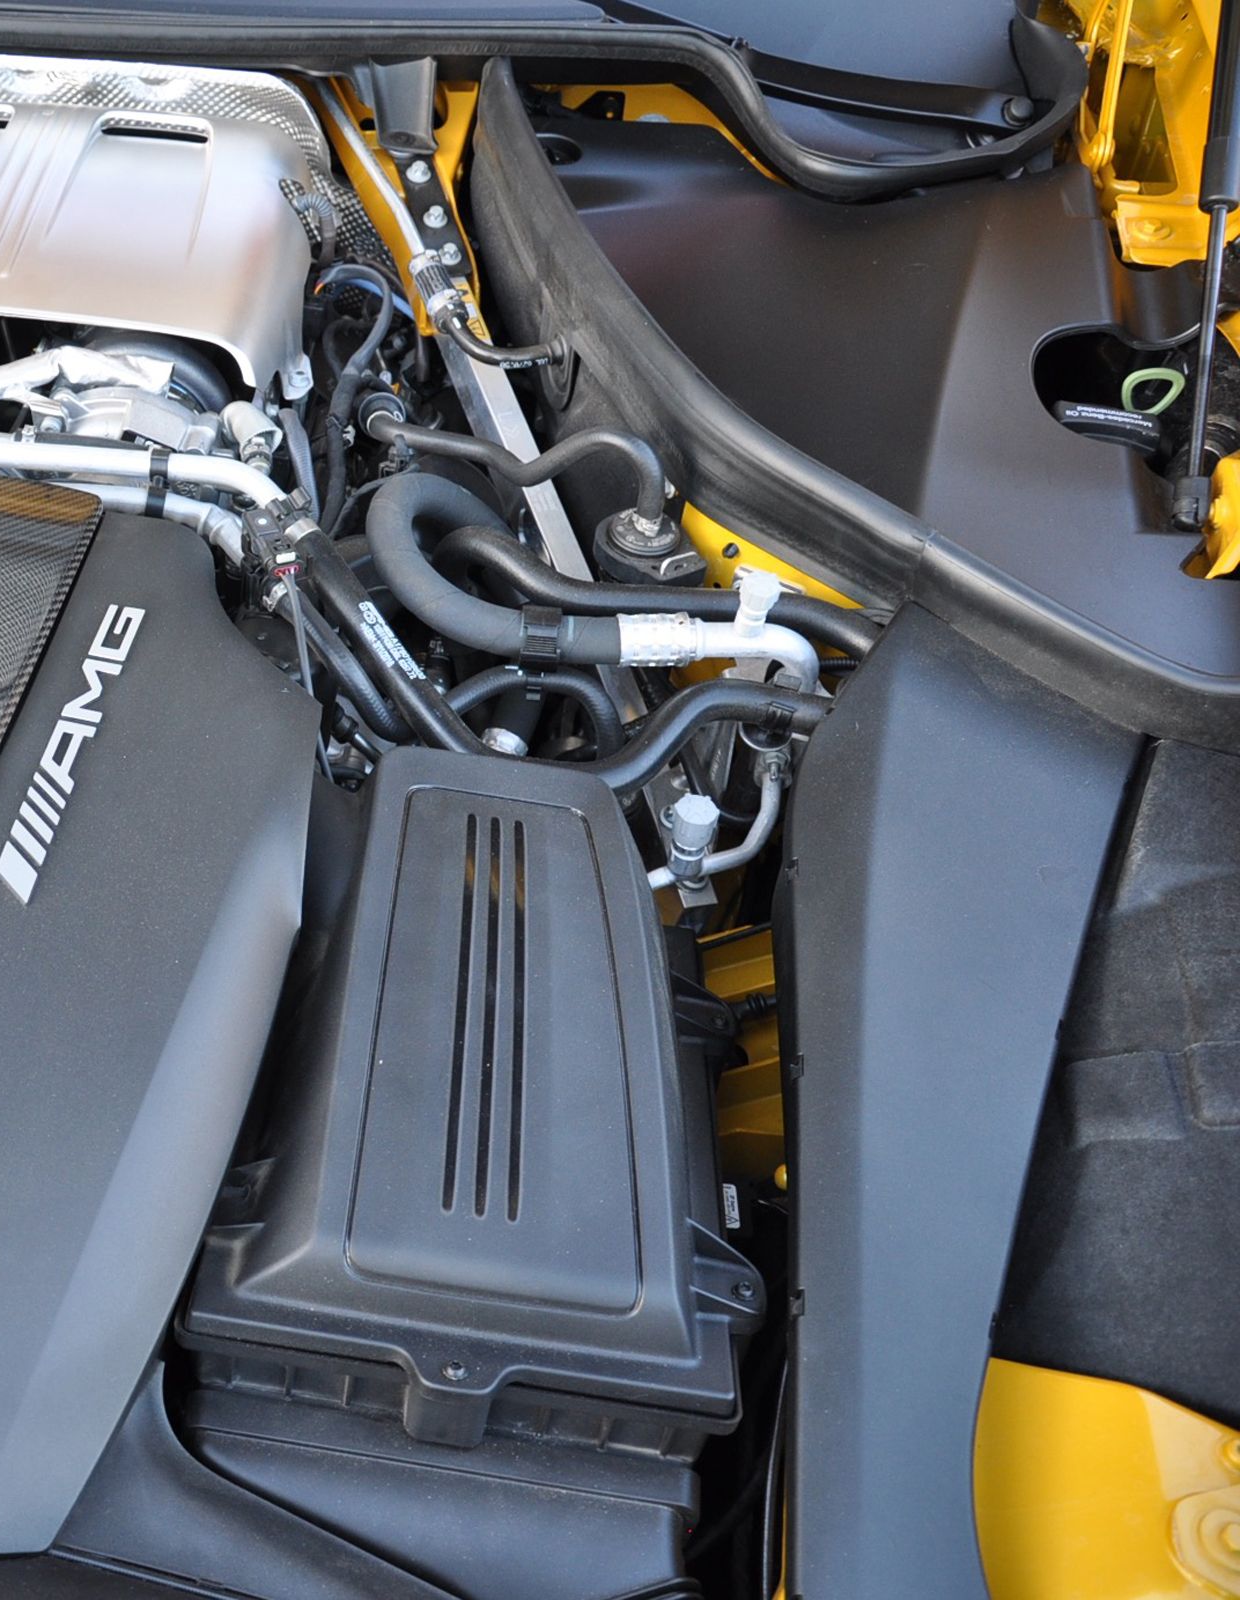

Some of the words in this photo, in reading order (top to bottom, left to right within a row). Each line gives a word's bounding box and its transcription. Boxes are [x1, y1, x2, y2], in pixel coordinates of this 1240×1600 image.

[1065, 409, 1079, 417] Oil
[1076, 405, 1142, 419] recommended
[1081, 410, 1153, 428] Mercedes-Benz
